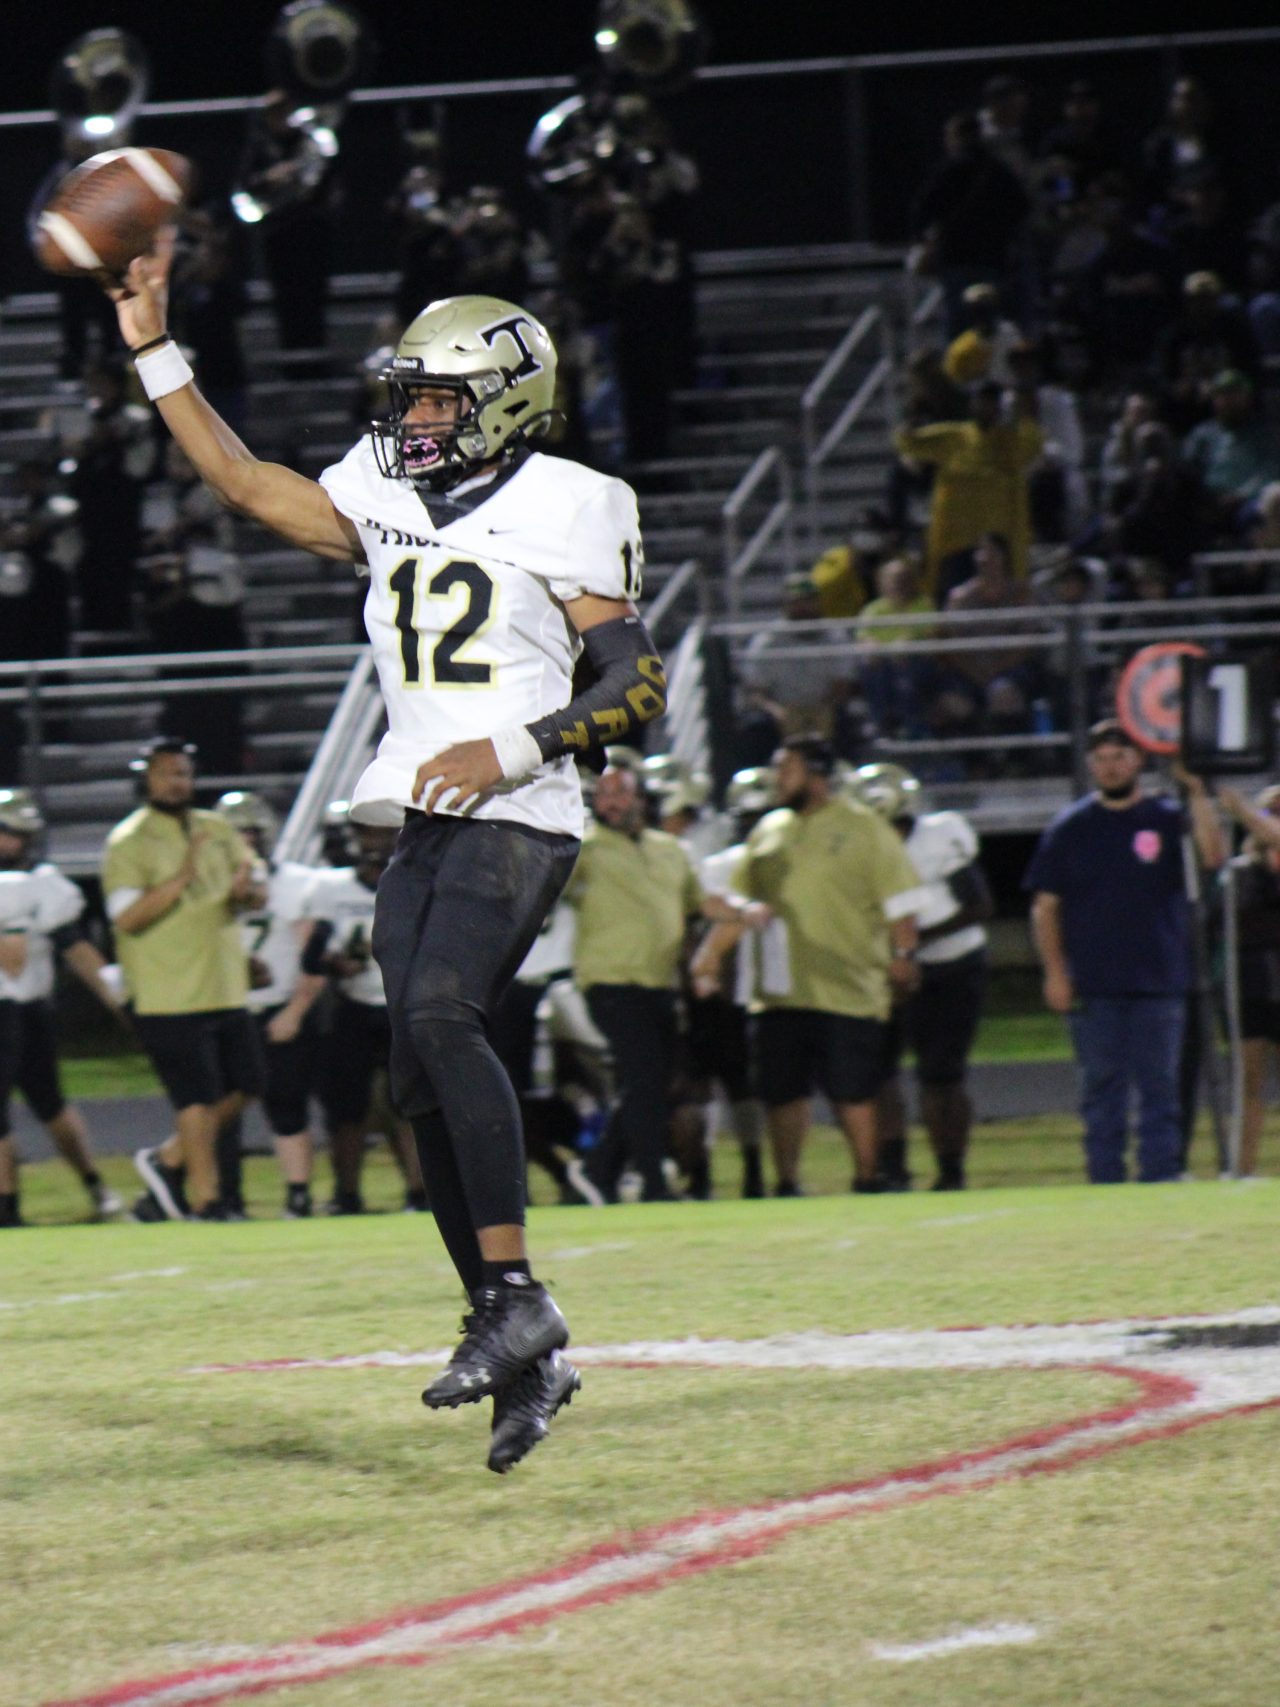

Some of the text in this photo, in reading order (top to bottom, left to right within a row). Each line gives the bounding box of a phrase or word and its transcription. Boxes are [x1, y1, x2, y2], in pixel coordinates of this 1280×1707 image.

[620, 540, 642, 594] 1
[389, 556, 500, 689] 12
[1209, 664, 1246, 750] 1
